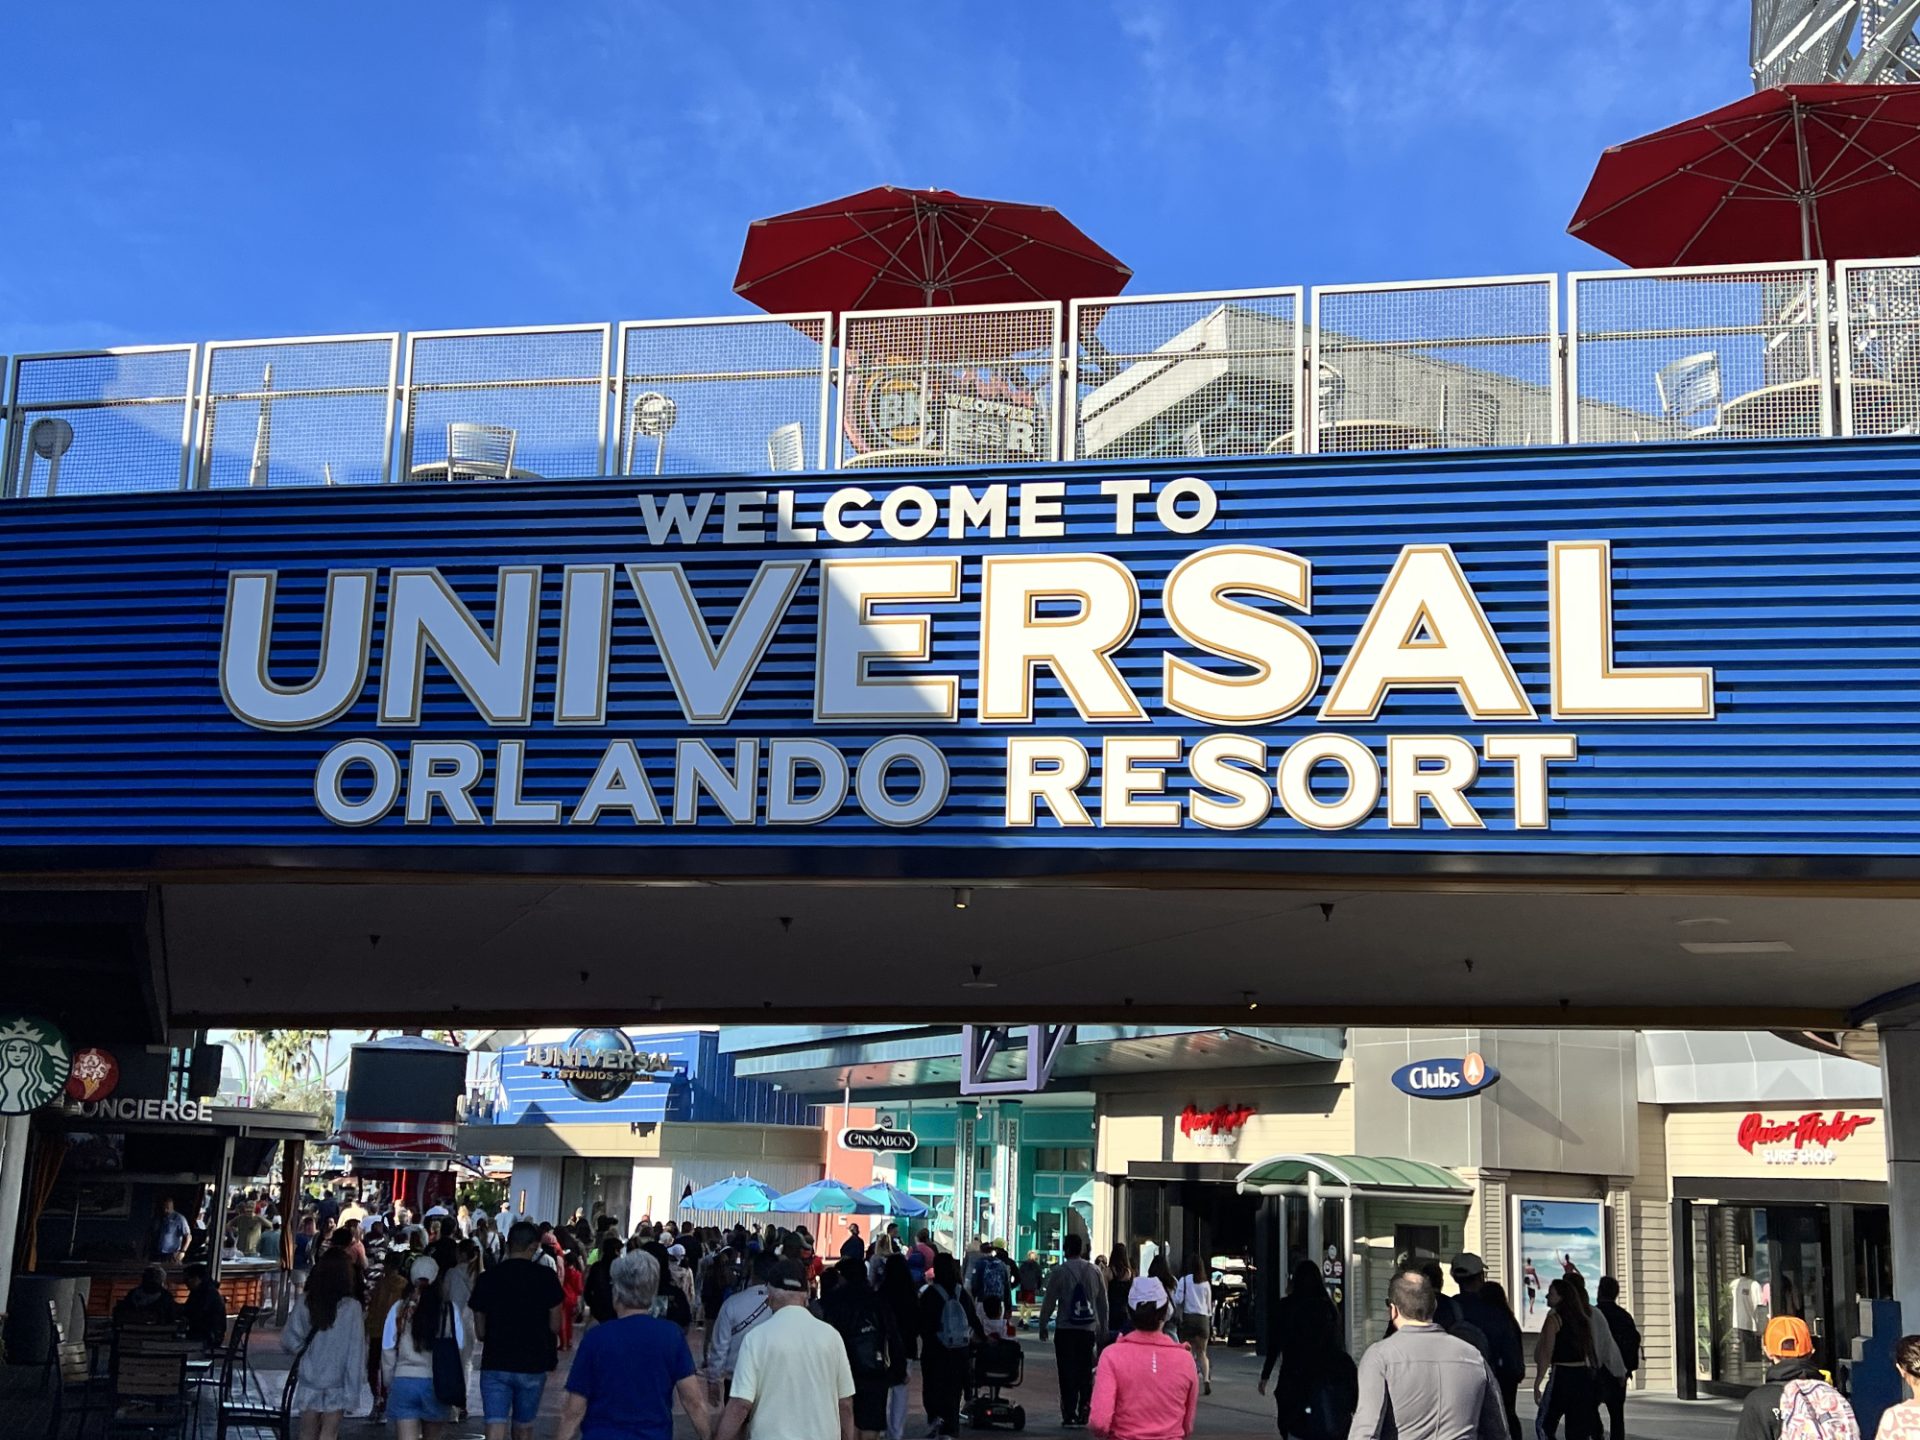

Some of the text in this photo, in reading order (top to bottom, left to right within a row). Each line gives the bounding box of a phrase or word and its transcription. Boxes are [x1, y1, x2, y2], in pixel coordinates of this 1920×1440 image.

[638, 476, 1218, 545] WELCOME TO
[218, 540, 1716, 732] UNIVERSAL
[313, 732, 1578, 831] ORLANDO RESORT
[529, 1045, 674, 1071] UNIVERSAL
[558, 1069, 614, 1081] STUDIOS
[1409, 1066, 1460, 1090] Clubs
[79, 1098, 213, 1122] ONCIERGE
[847, 1132, 911, 1148] CINNABON
[1764, 1149, 1835, 1162] SURF SHOP
